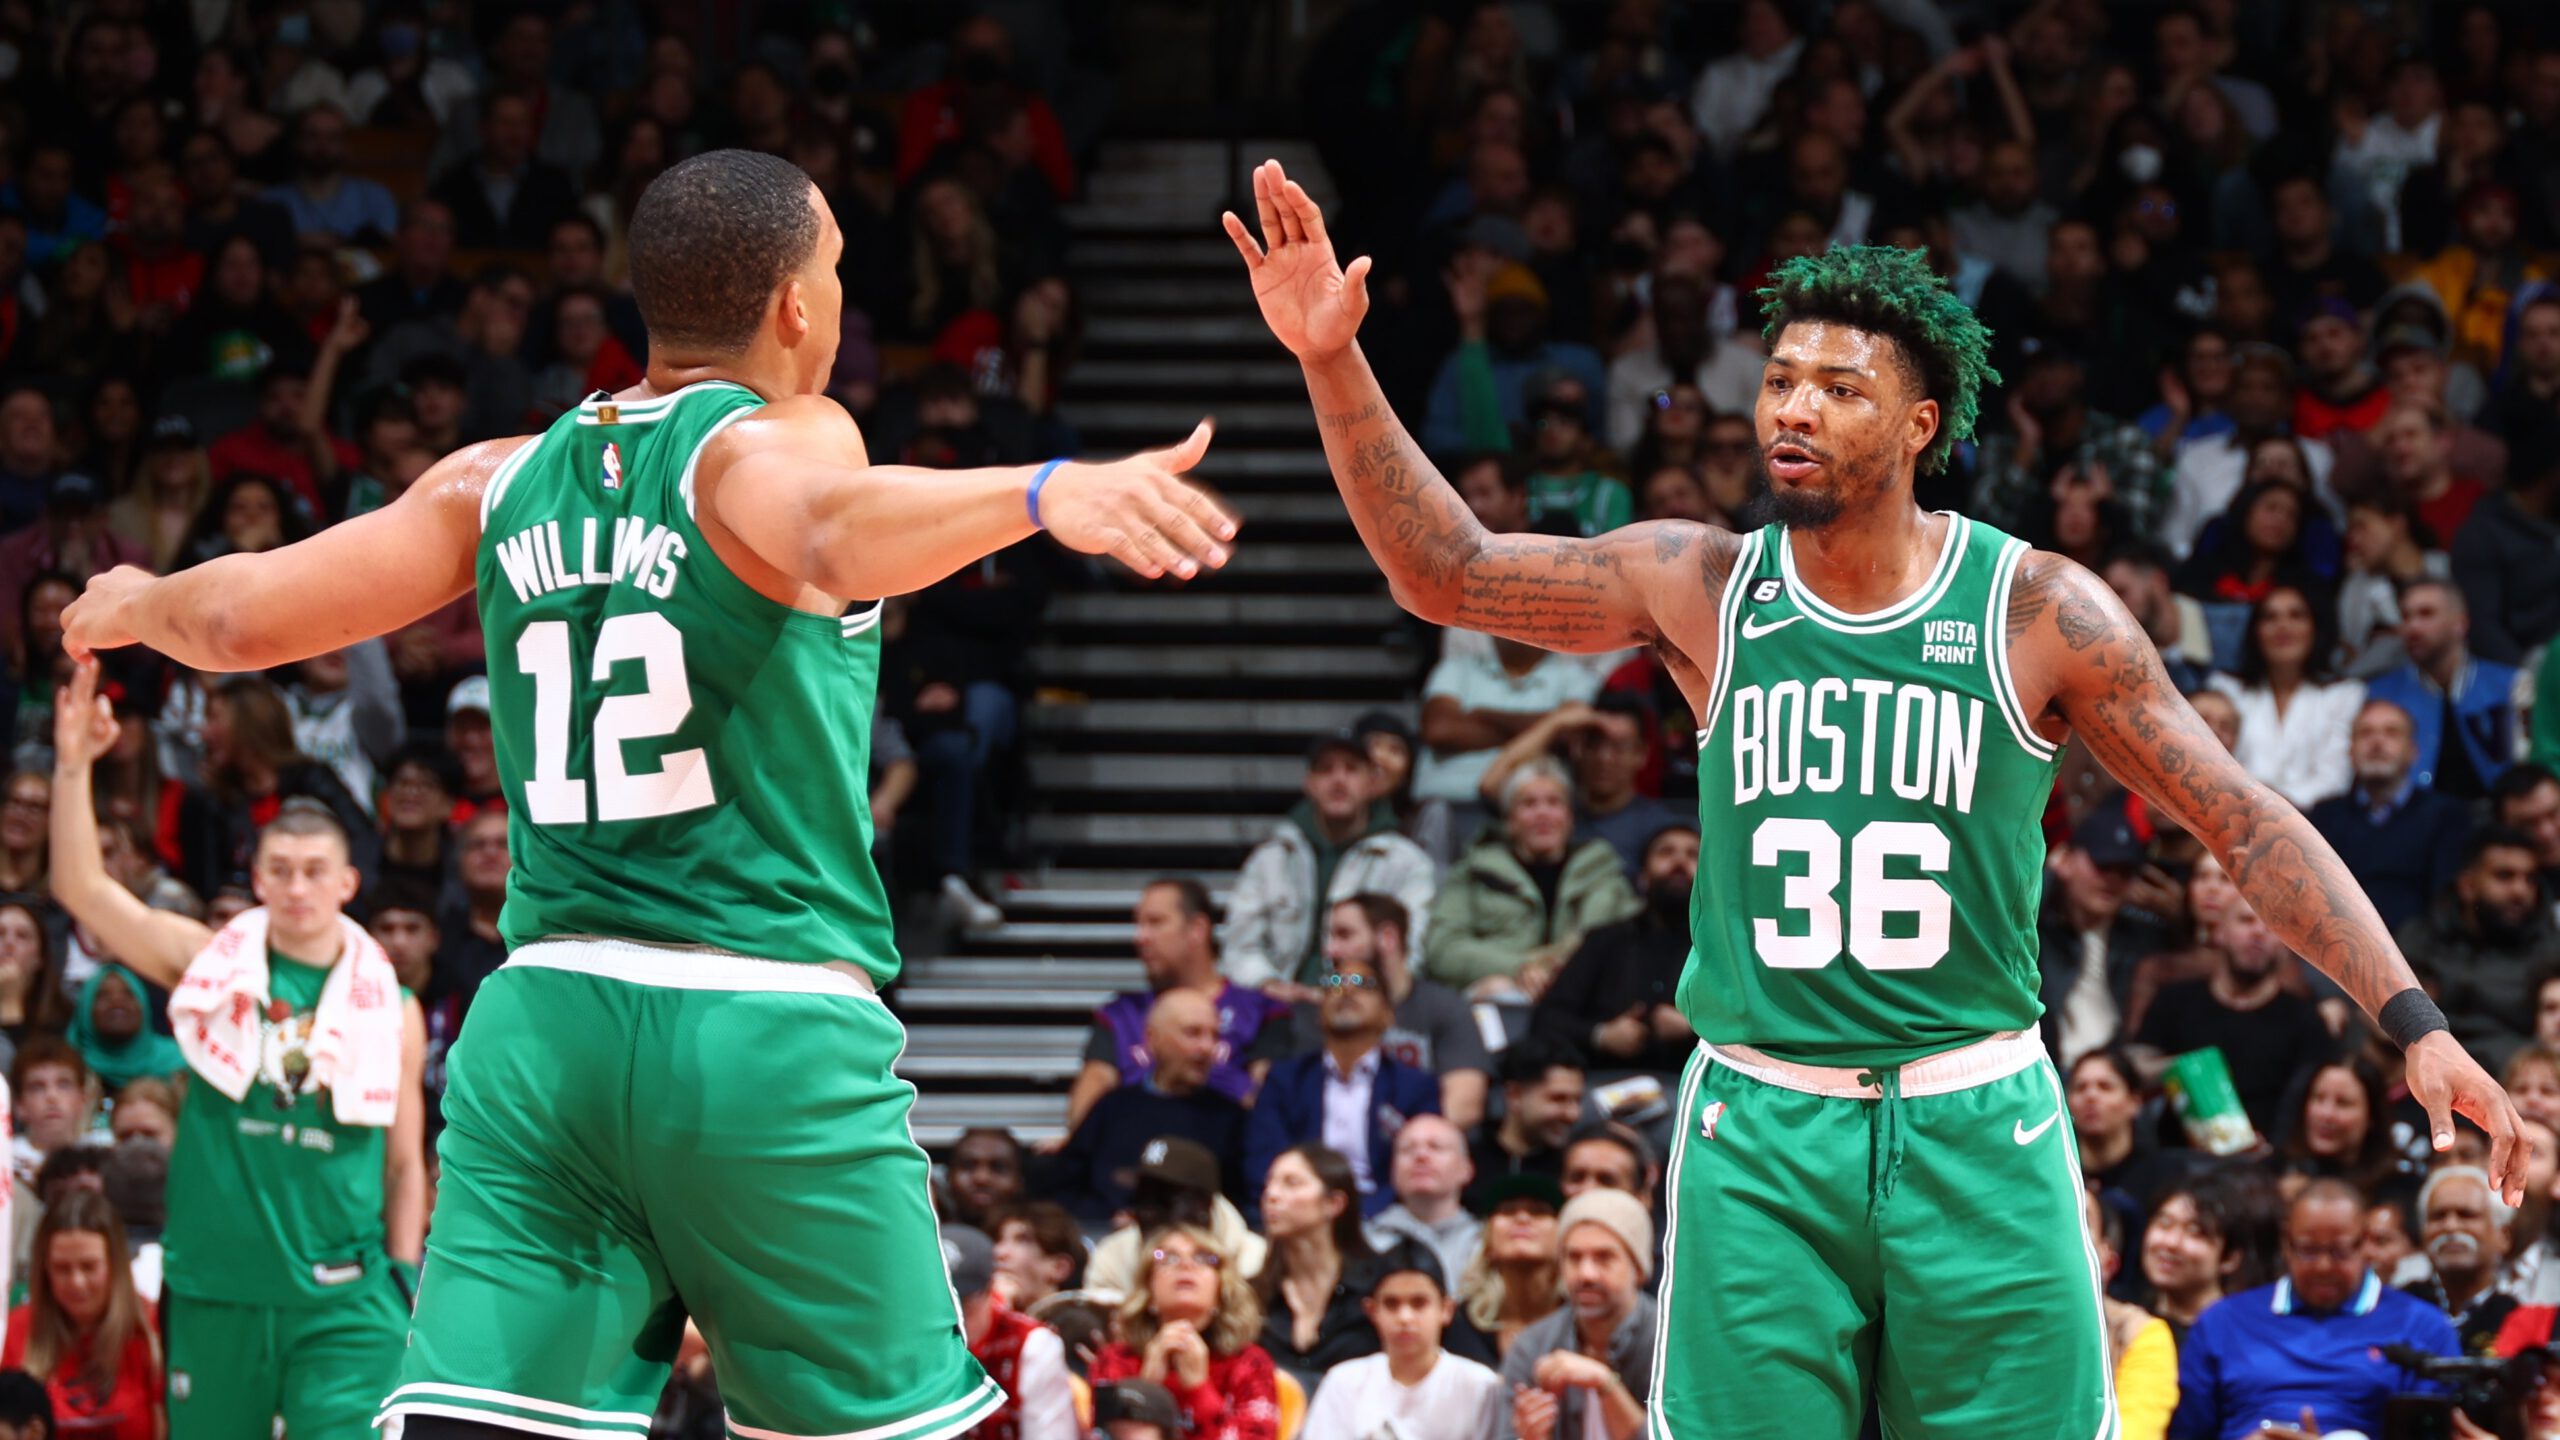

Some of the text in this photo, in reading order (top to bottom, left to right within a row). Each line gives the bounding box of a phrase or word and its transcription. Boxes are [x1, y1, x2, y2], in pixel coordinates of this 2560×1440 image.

[496, 515, 688, 603] WILLIMS
[1753, 580, 1781, 602] 6
[1922, 644, 1977, 665] PRINT
[1923, 620, 1977, 646] VISTA
[516, 611, 716, 825] 12
[1733, 677, 1984, 814] BOSTON
[1752, 817, 1952, 971] 36
